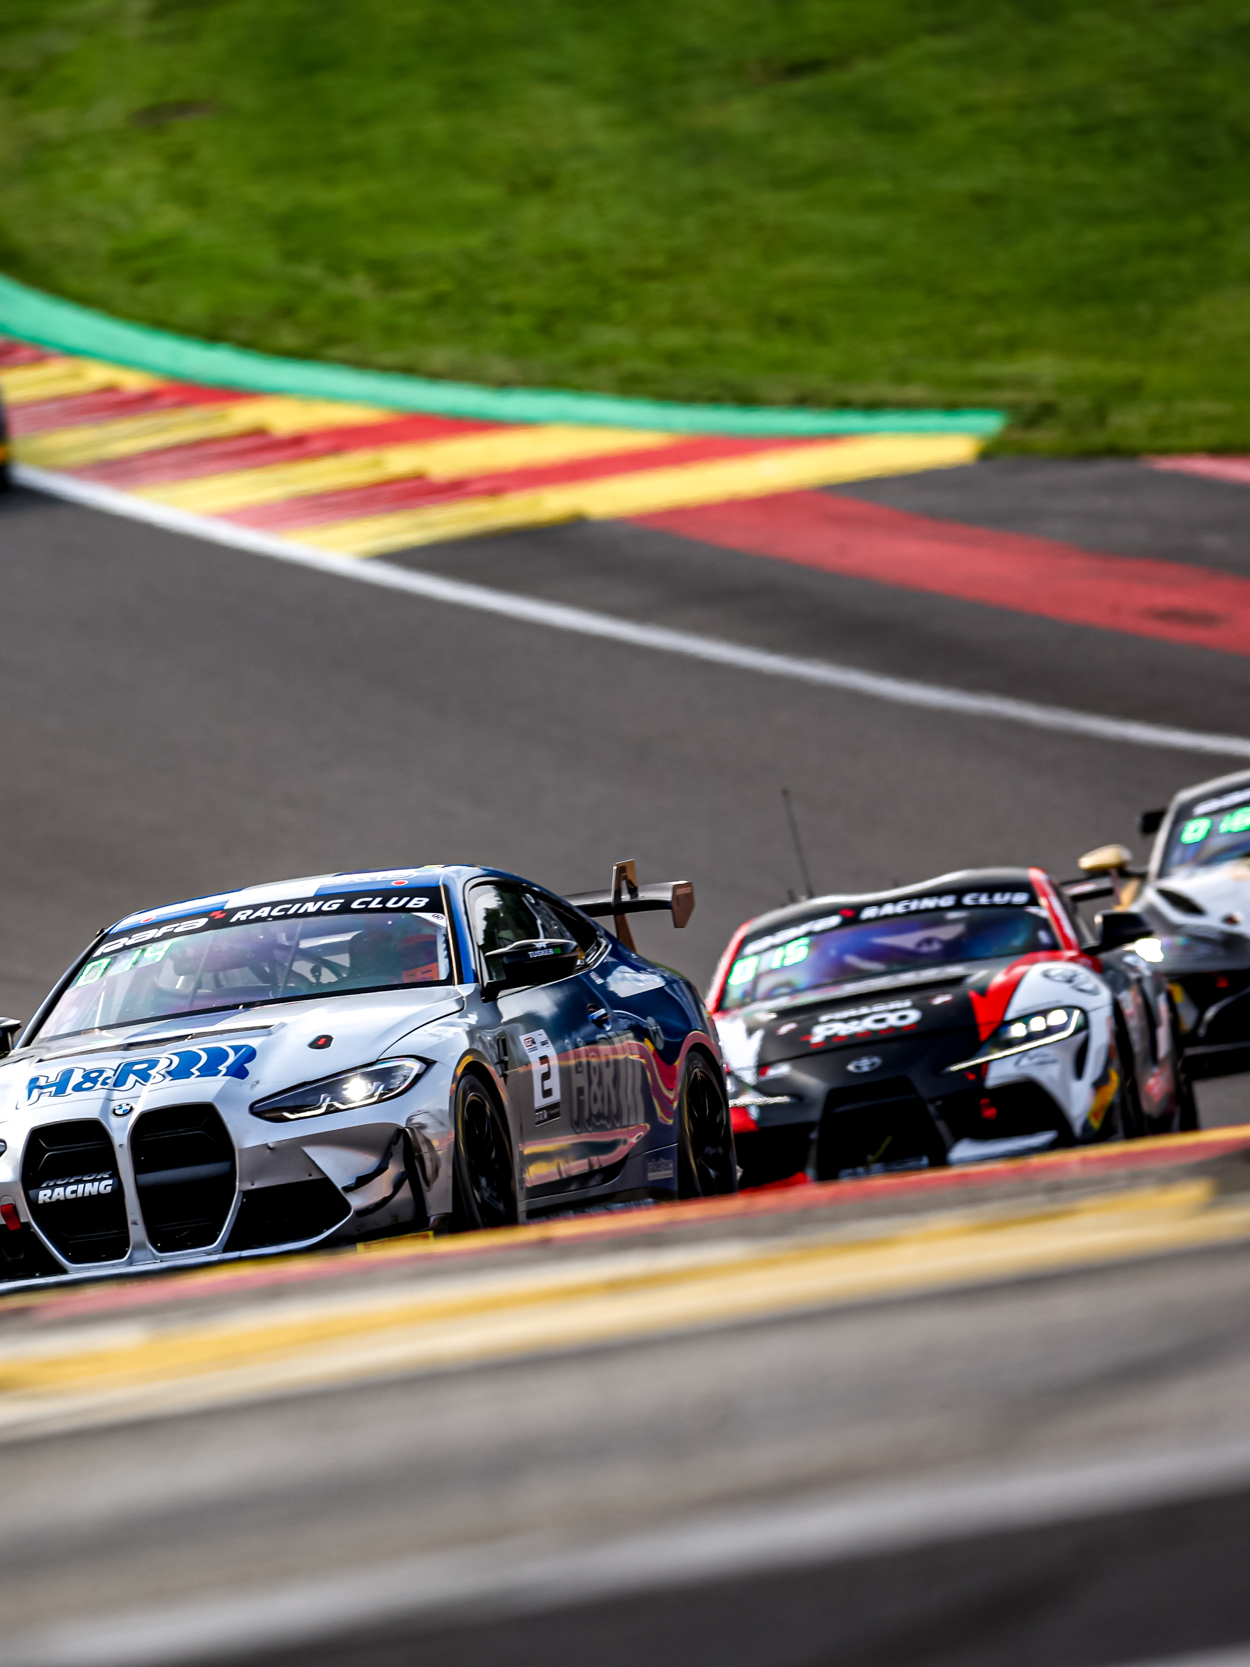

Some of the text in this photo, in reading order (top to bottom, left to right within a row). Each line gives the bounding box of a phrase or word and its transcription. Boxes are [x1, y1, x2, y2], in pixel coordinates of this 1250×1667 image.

[230, 899, 345, 922] RACING
[350, 896, 430, 909] CLUB
[860, 892, 1030, 921] RACING CLUB
[124, 940, 173, 971] 14
[18, 1056, 174, 1109] H&R
[538, 1055, 553, 1099] 2
[38, 1179, 113, 1204] RACING
[41, 1170, 112, 1187] HOFOR
